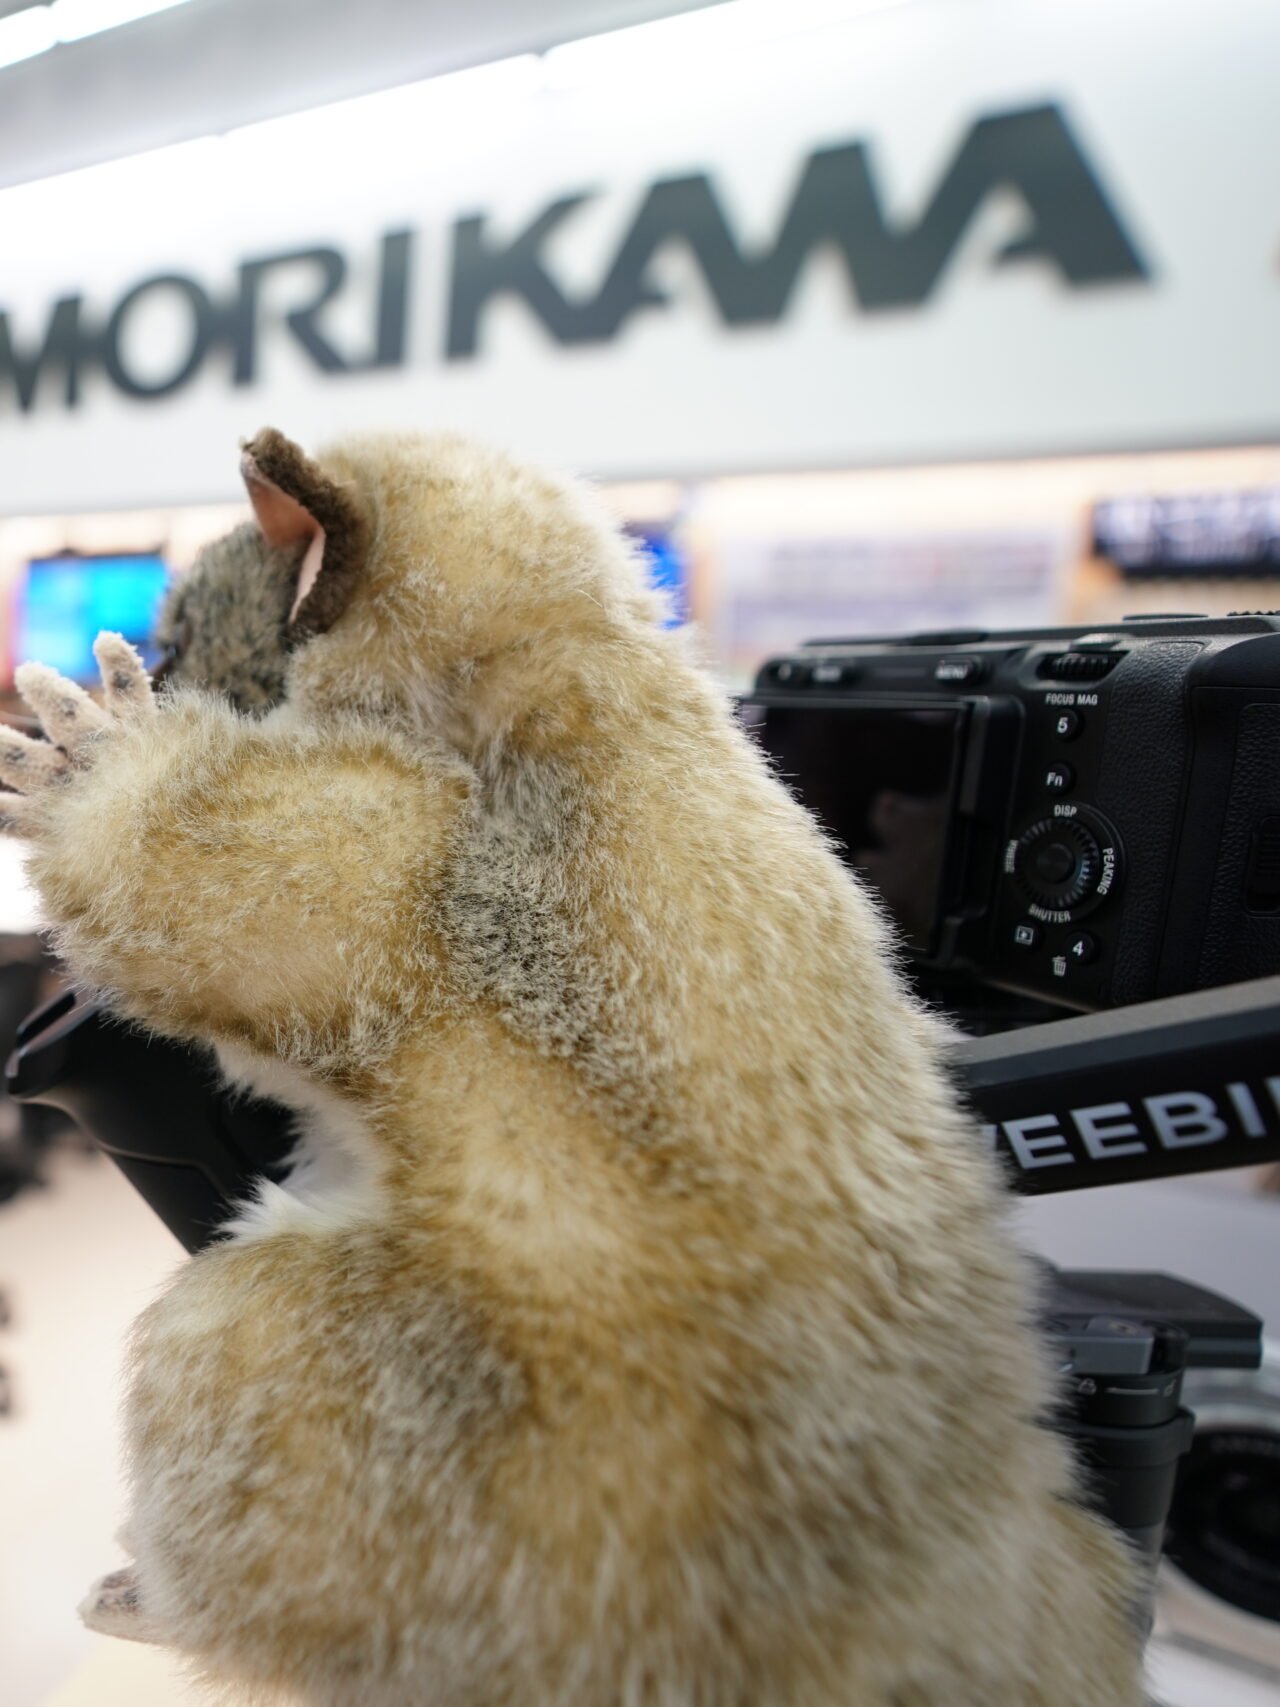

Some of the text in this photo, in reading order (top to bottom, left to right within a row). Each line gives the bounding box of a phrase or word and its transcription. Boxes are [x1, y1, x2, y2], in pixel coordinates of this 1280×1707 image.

[1045, 693, 1098, 706] FOCUS MAG
[1057, 717, 1068, 733] 5
[1046, 772, 1063, 786] Fn
[1054, 804, 1077, 818] DISP
[1097, 847, 1115, 896] PEAKING
[1028, 903, 1071, 923] SHUTTER
[1072, 941, 1084, 956] 4
[979, 1076, 1280, 1169] EEBI
